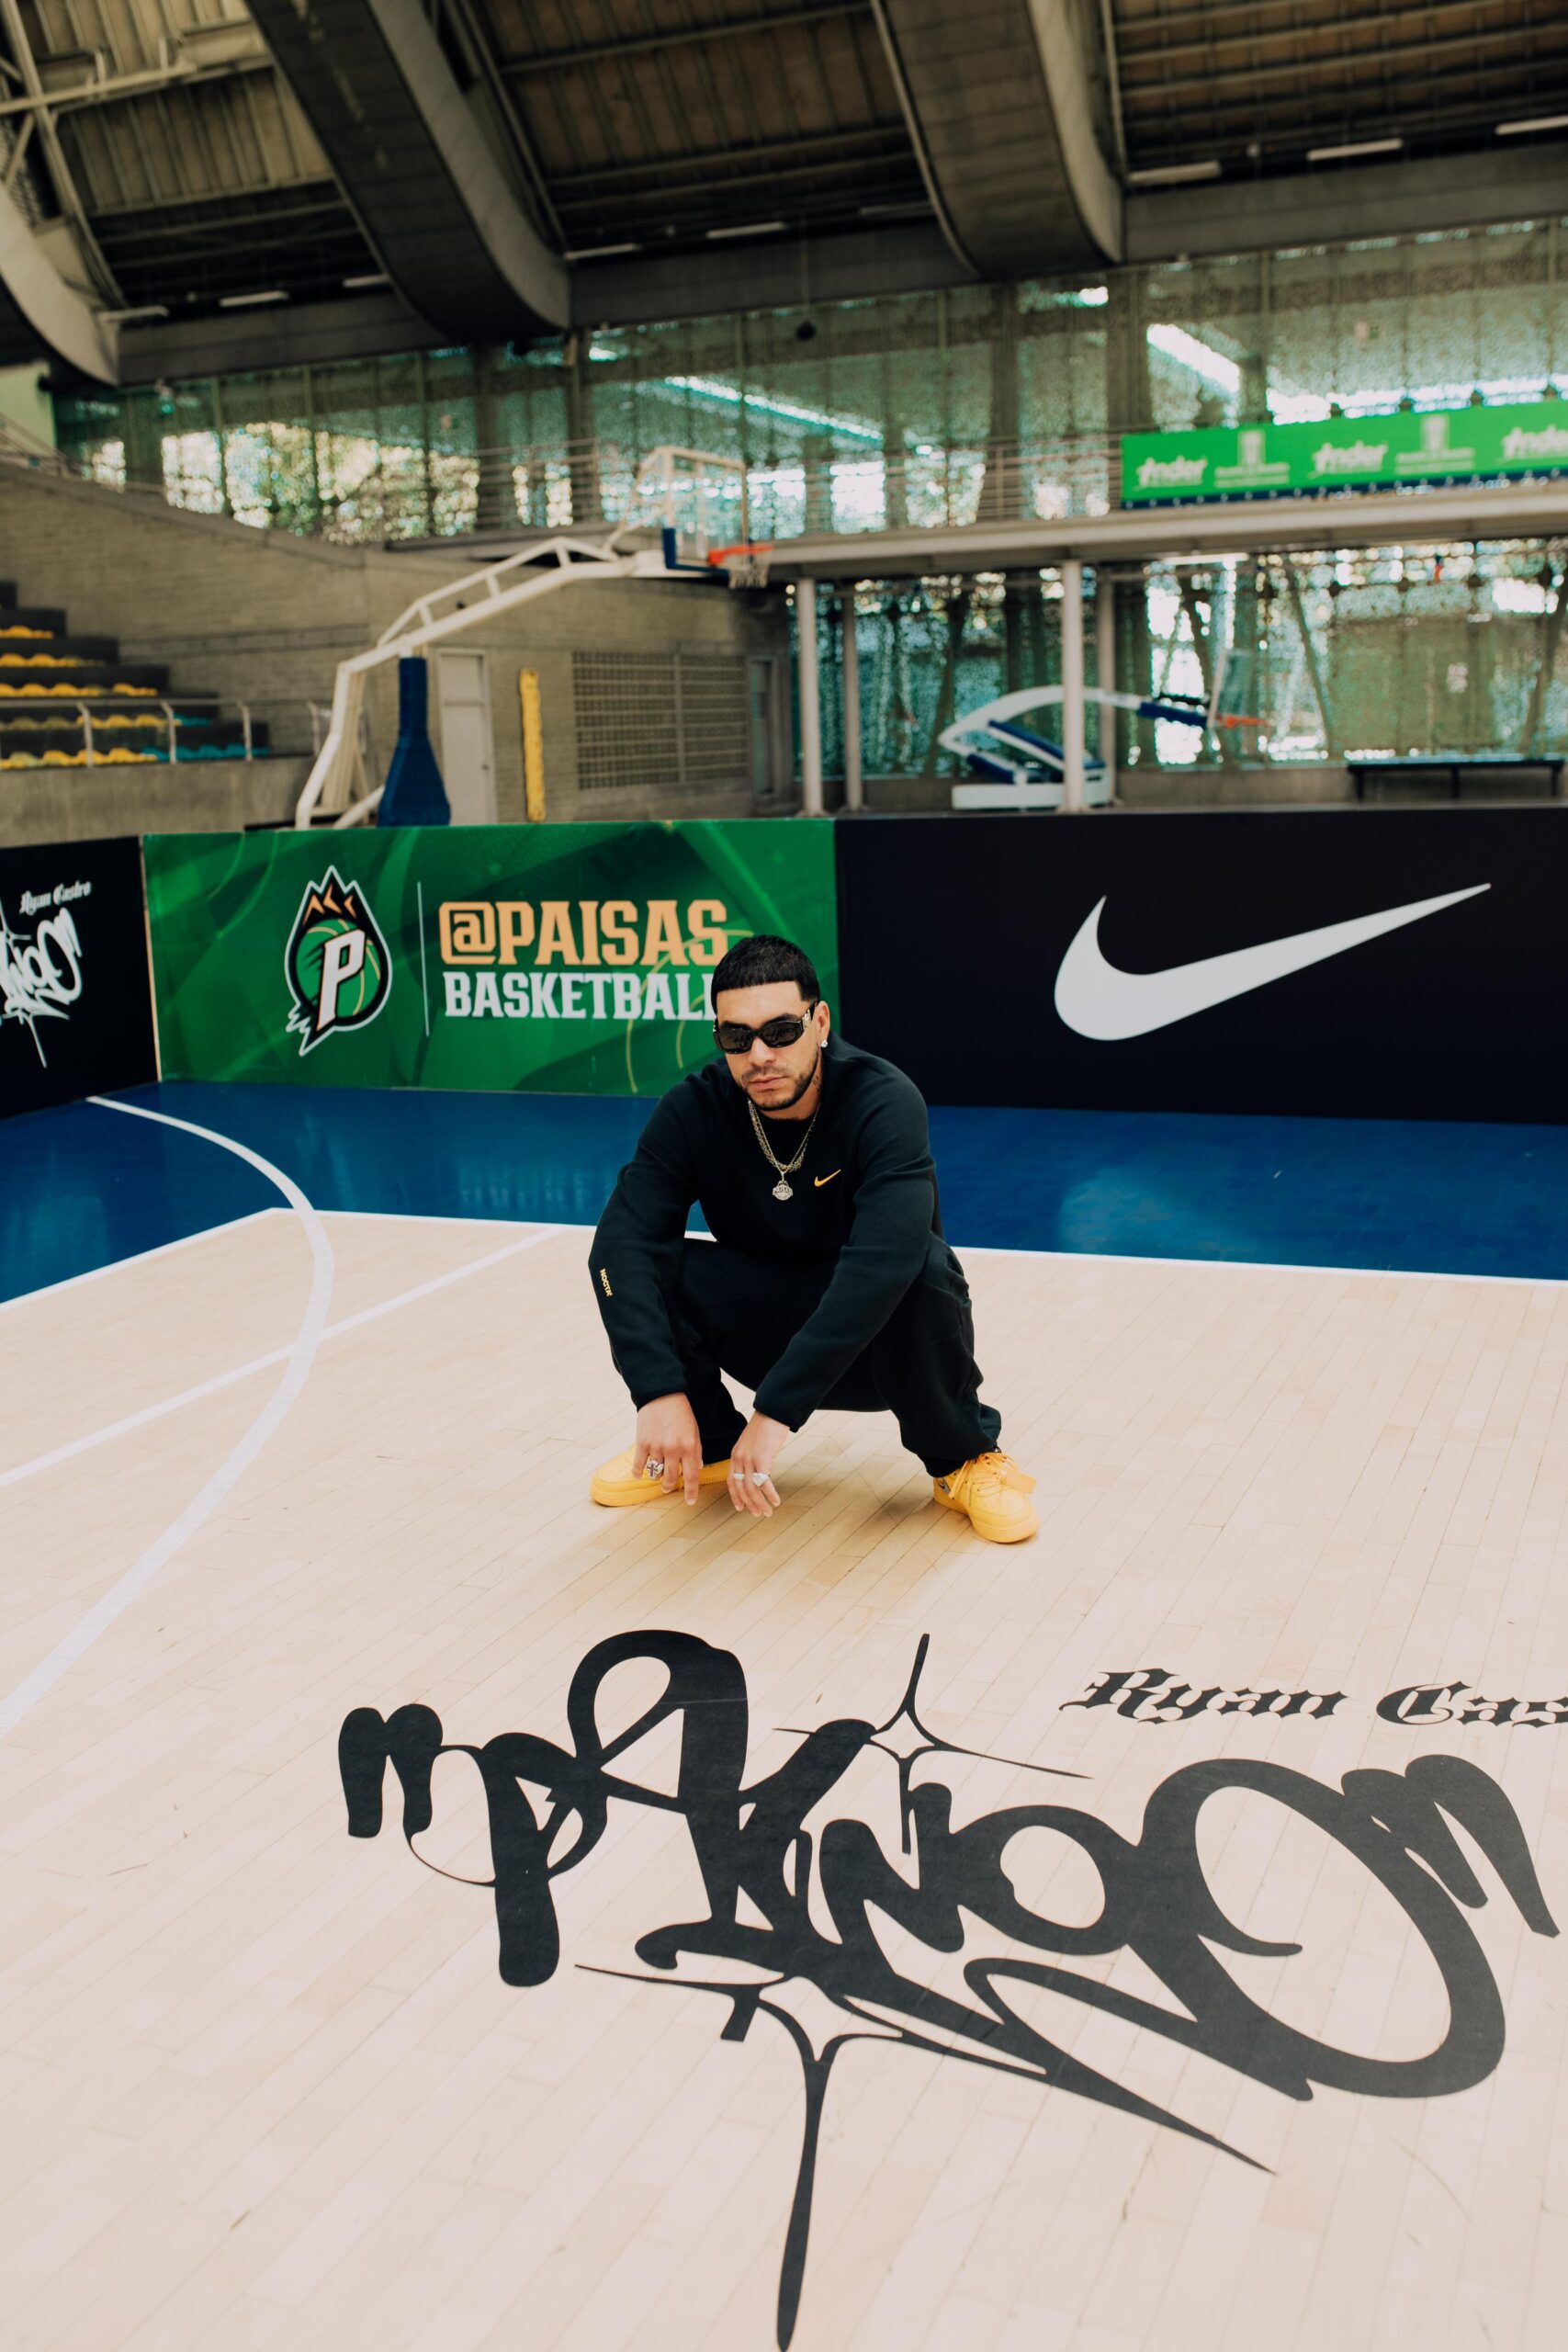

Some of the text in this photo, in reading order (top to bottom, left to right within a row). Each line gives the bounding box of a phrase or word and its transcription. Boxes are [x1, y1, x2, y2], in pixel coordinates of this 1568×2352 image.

[438, 899, 728, 966] @PAISAS
[316, 928, 366, 1032] P
[600, 1268, 613, 1297] NOCTA
[1058, 1668, 1568, 1728] Ryan Cas
